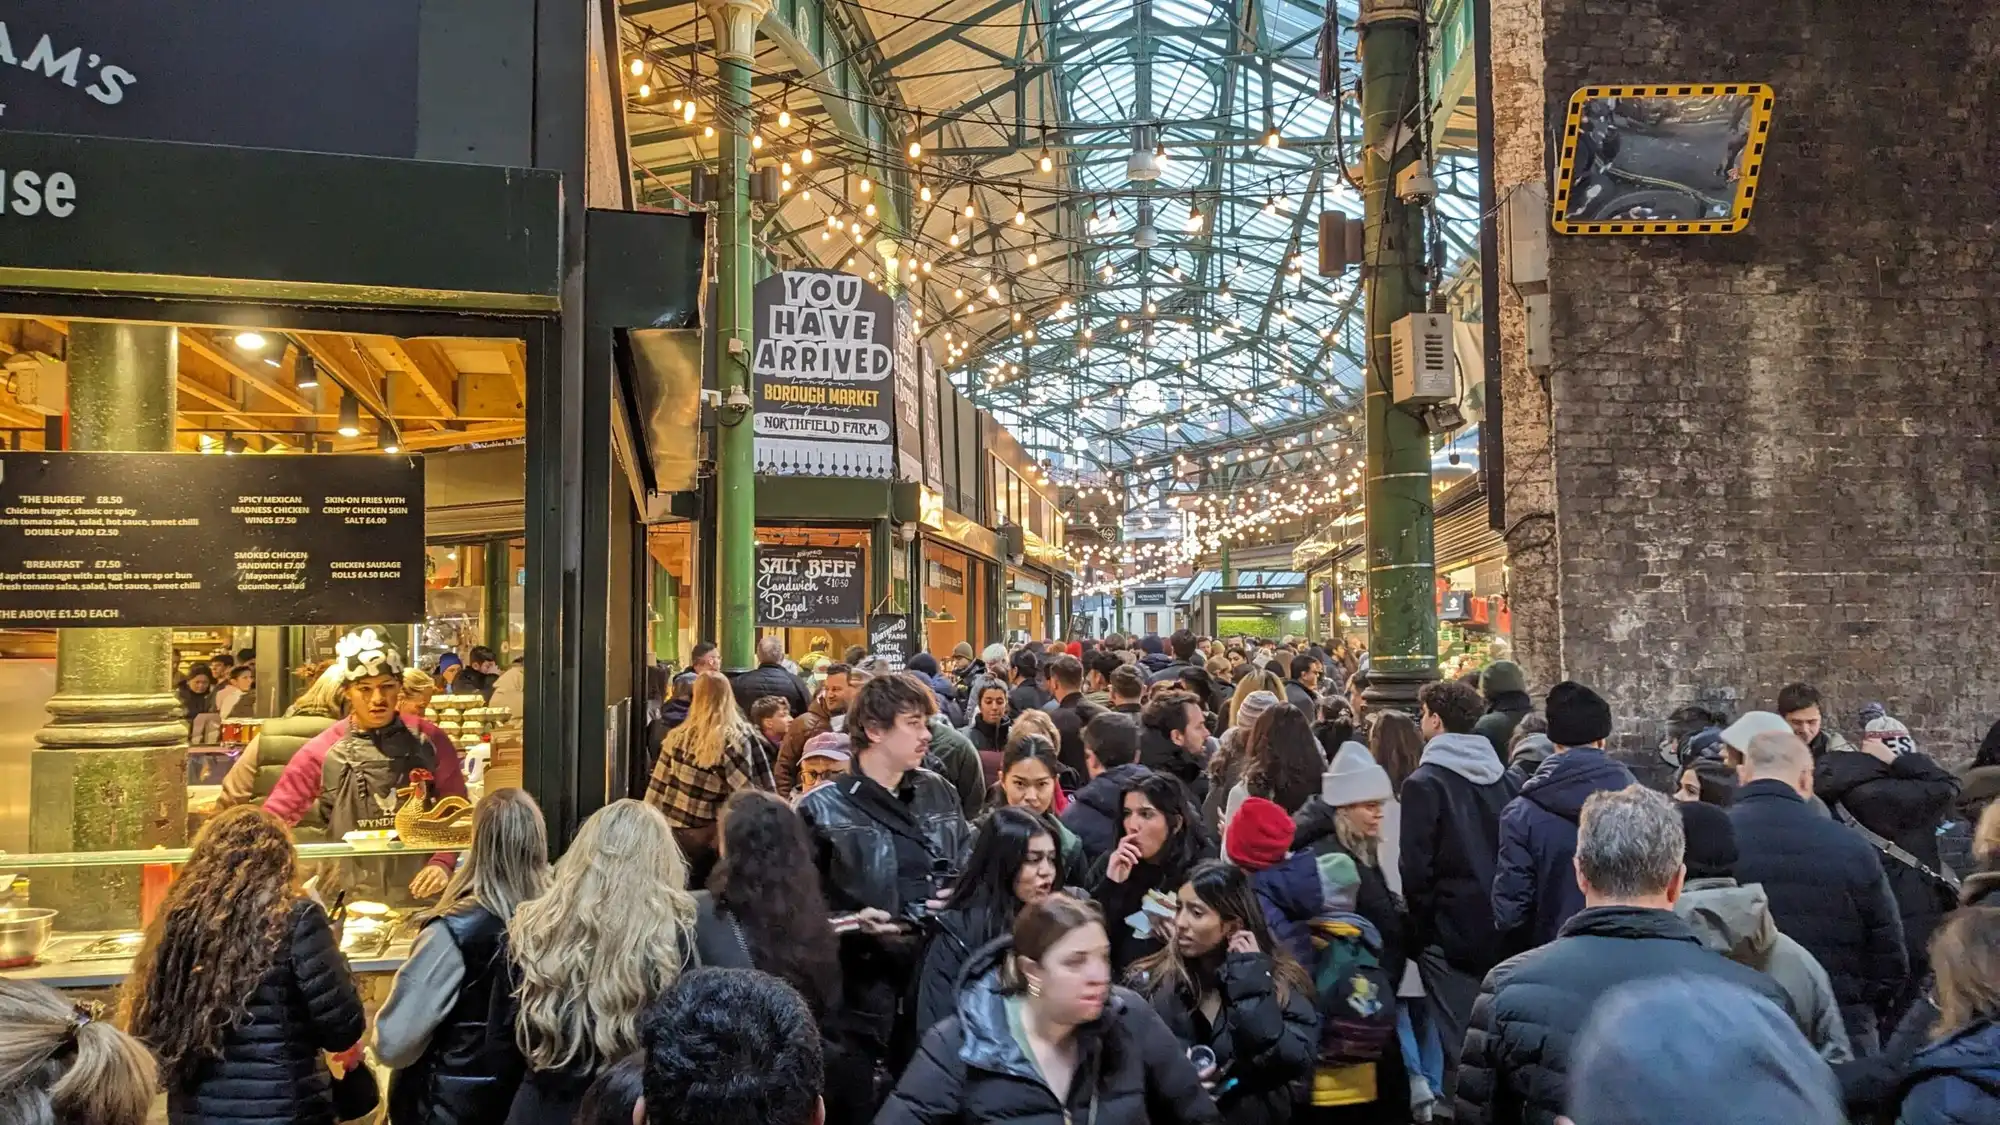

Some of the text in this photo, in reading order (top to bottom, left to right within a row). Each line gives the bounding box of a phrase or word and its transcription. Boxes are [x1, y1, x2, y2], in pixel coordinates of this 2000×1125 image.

[785, 274, 860, 309] YOU
[772, 307, 872, 342] HAVE
[756, 341, 890, 377] ARRIVED
[791, 376, 855, 386] London
[764, 383, 879, 407] BOROUGH MARKET
[781, 400, 859, 416] England
[764, 416, 878, 436] NORTHFIELD FARM
[96, 496, 123, 504] £8.50
[324, 496, 406, 504] SKIN-ON FRIES WITH
[5, 507, 40, 515] Chicken
[41, 507, 73, 516] burger,
[74, 507, 102, 515] classic
[114, 507, 137, 516] spicy
[231, 506, 310, 514] MADNESS CHICKEN
[20, 518, 52, 526] tomato
[53, 518, 78, 526] salsa,
[79, 518, 105, 526] salad,
[106, 518, 122, 526] hot
[151, 518, 177, 526] sweet
[178, 518, 200, 526] chilli
[24, 528, 119, 536] DOUBLE-UP ADD £2.50
[95, 560, 121, 568] £7.50
[236, 562, 282, 570] SANDWICH
[759, 558, 856, 579] SALT BEEF
[5, 572, 36, 581] apricot
[37, 573, 72, 581] sausage
[107, 573, 122, 581] egg
[140, 573, 163, 581] wrap
[175, 571, 193, 579] bun
[55, 583, 80, 591] salsa,
[81, 583, 107, 591] salad,
[108, 582, 123, 590] hot
[180, 582, 201, 590] chilli
[237, 582, 305, 591] cucumber, salad
[757, 574, 818, 599] Sandwich
[765, 593, 808, 620] Bagel
[19, 609, 57, 619] ABOVE
[58, 609, 87, 618] £1.50
[89, 609, 119, 618] EACH
